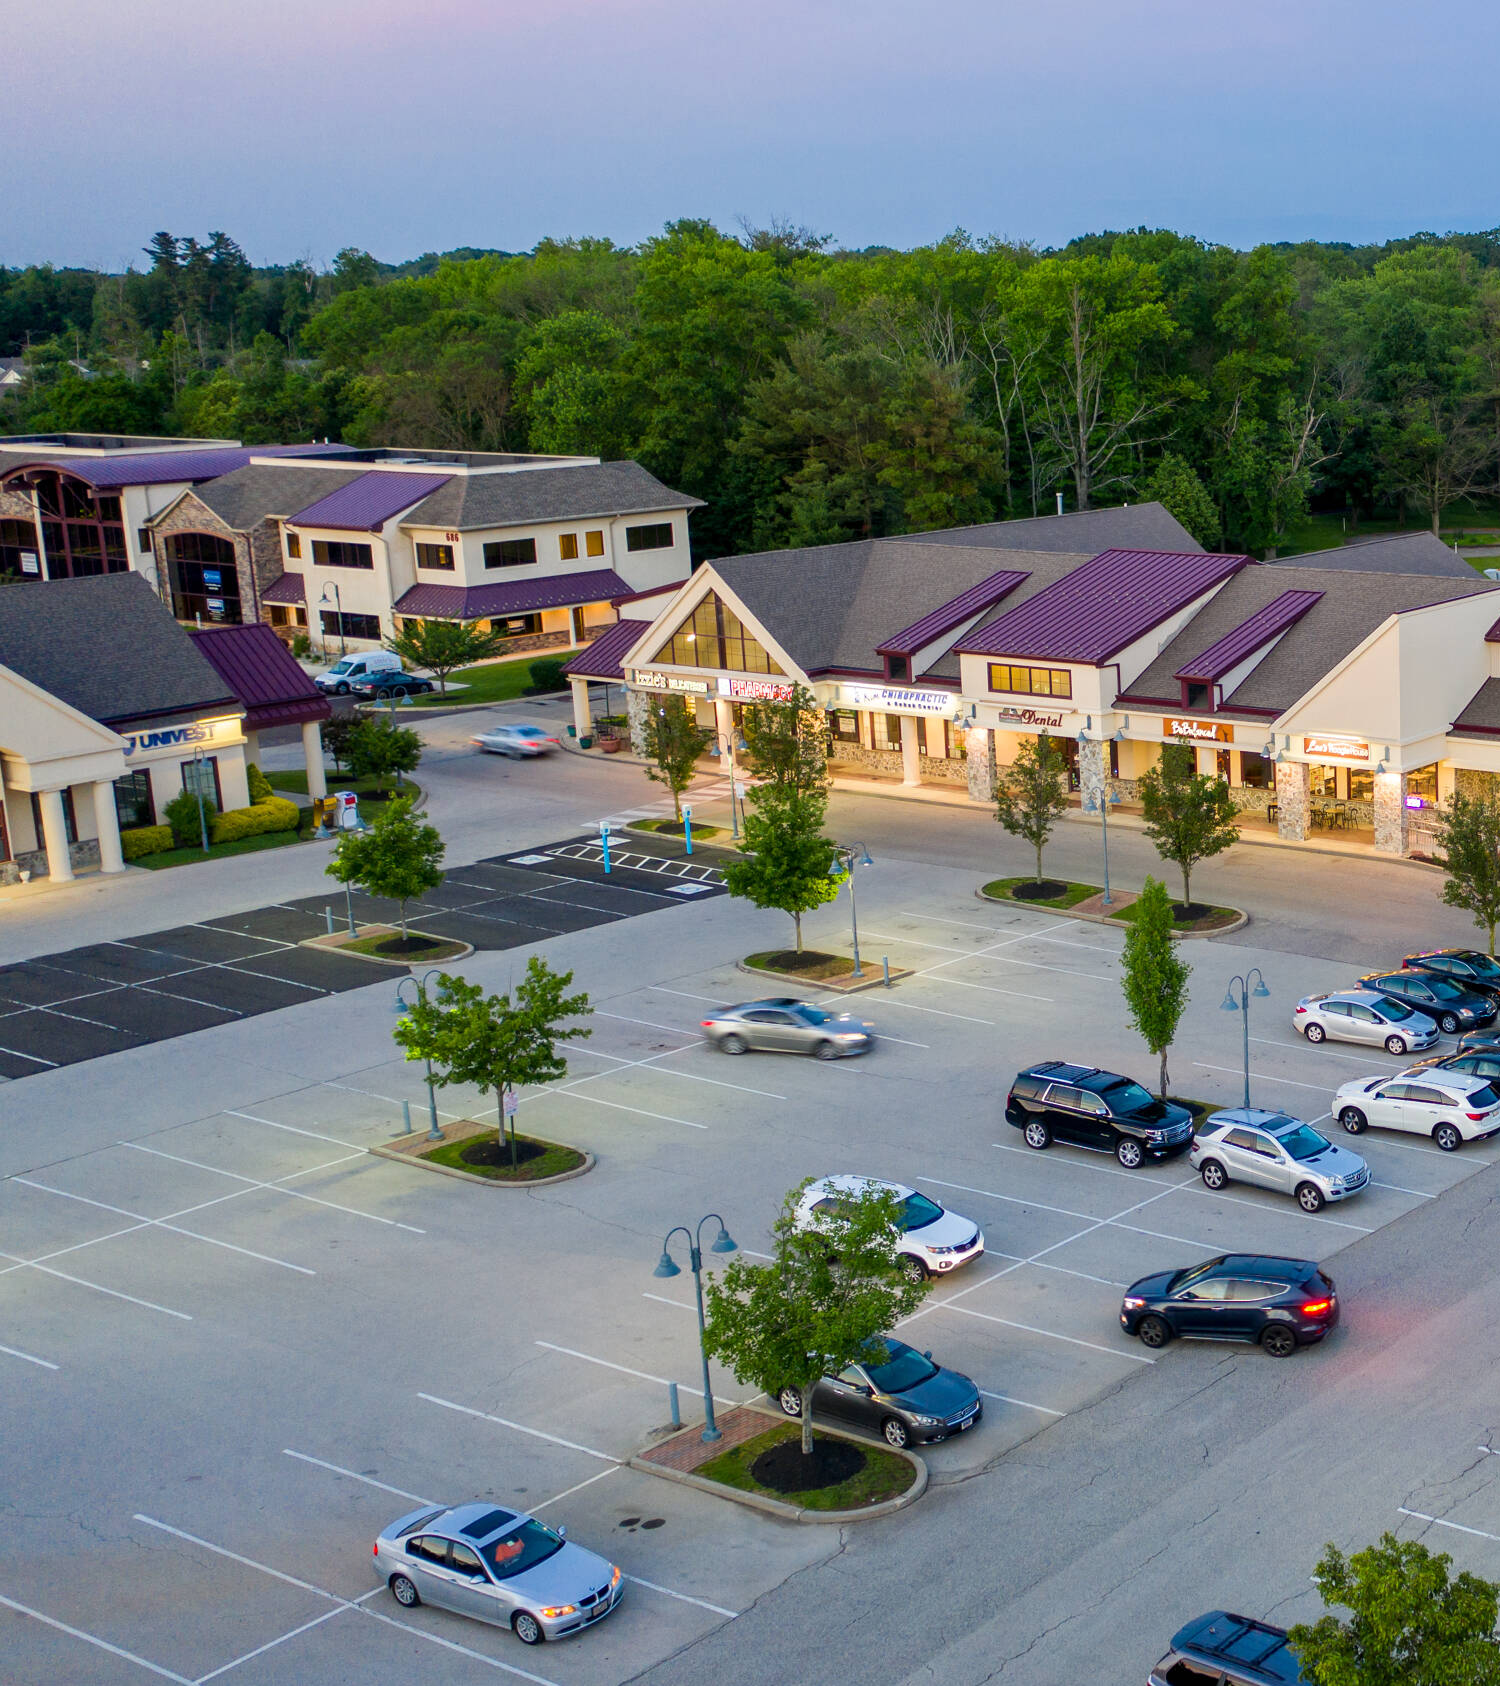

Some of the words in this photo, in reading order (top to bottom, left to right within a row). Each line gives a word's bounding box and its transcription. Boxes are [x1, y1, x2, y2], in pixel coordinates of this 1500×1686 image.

[731, 680, 794, 701] PHARMACY
[881, 689, 948, 704] CHIROPRACTIC
[1021, 709, 1063, 727] Dental
[139, 724, 216, 748] UNIVEST
